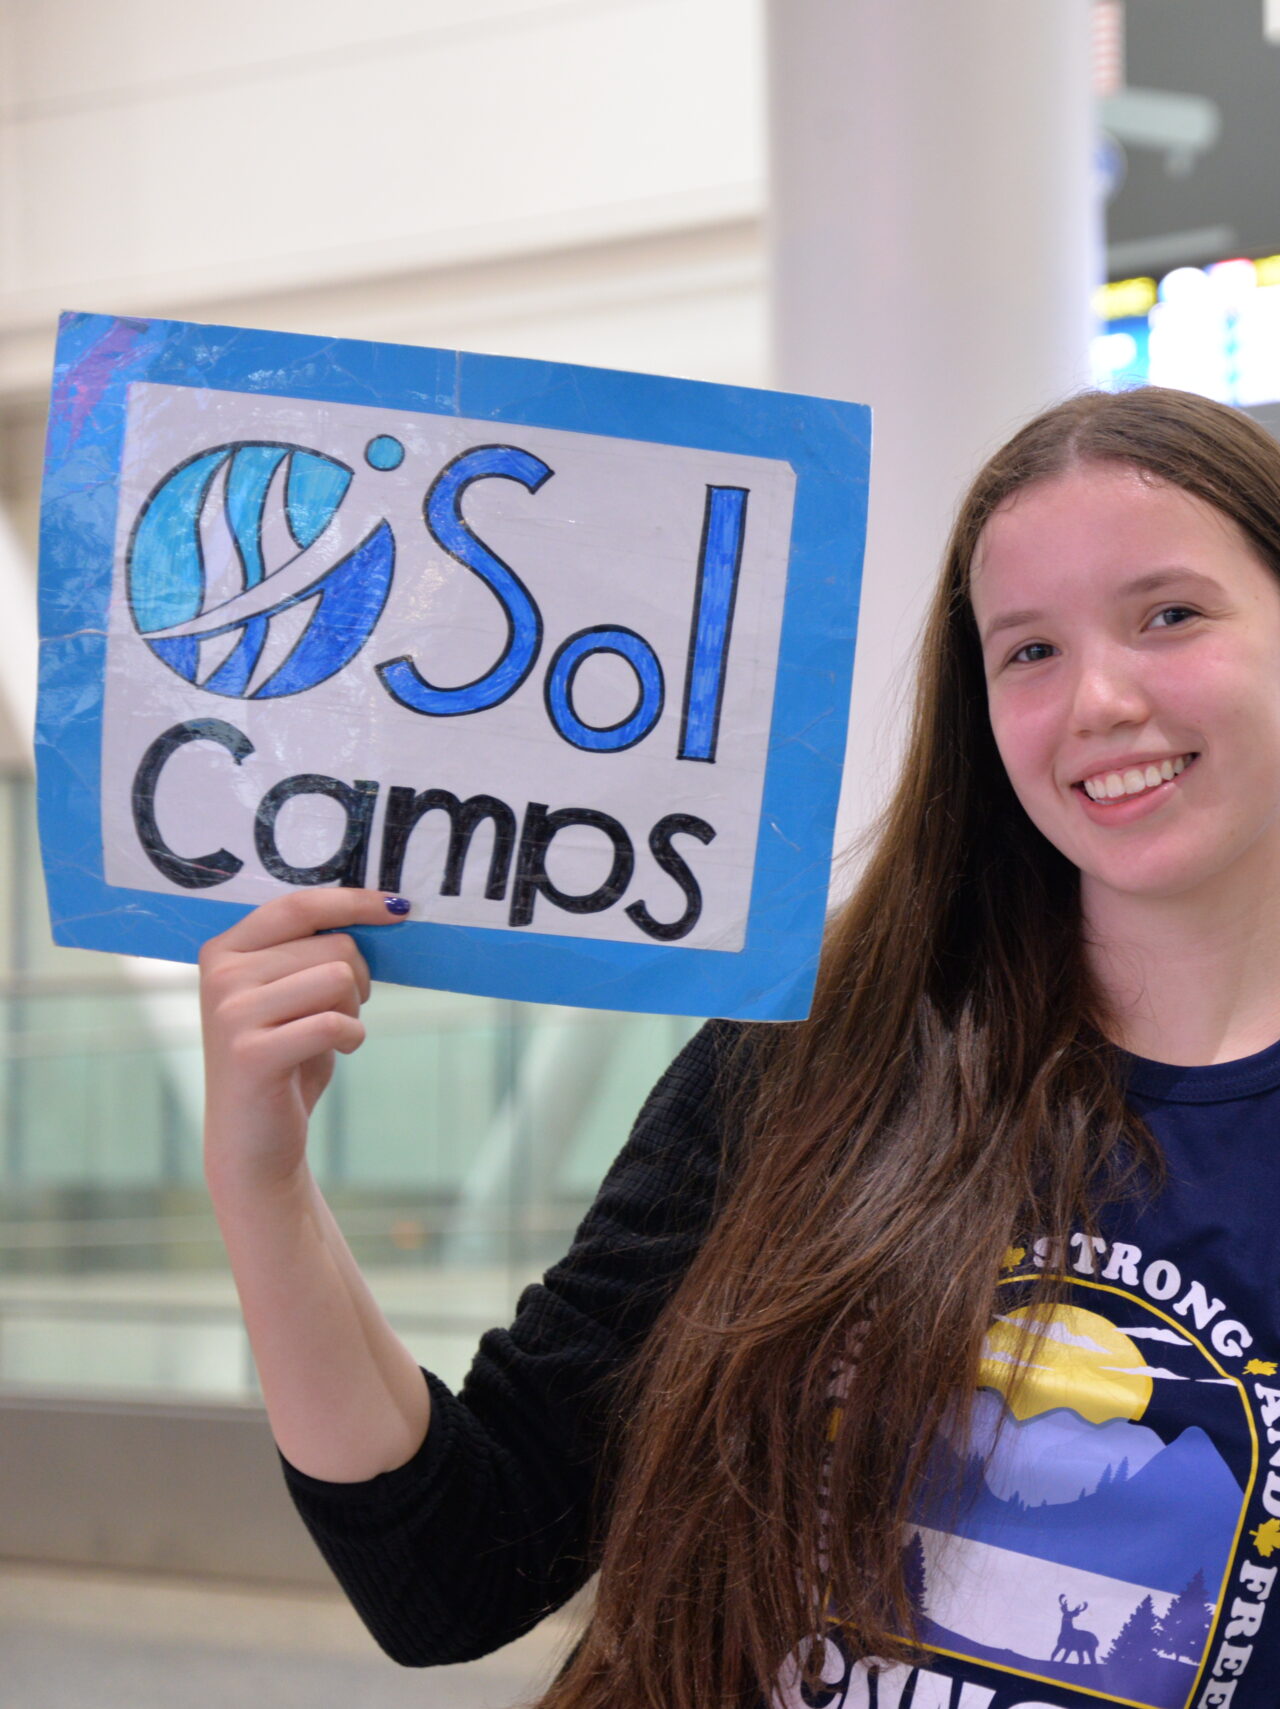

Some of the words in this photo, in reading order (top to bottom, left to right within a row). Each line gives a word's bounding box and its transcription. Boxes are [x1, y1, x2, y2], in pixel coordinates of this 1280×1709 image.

[375, 443, 750, 763] Sol
[131, 717, 717, 941] Camps
[1032, 1232, 1253, 1358] STRONG
[1197, 1559, 1278, 1709] FREE
